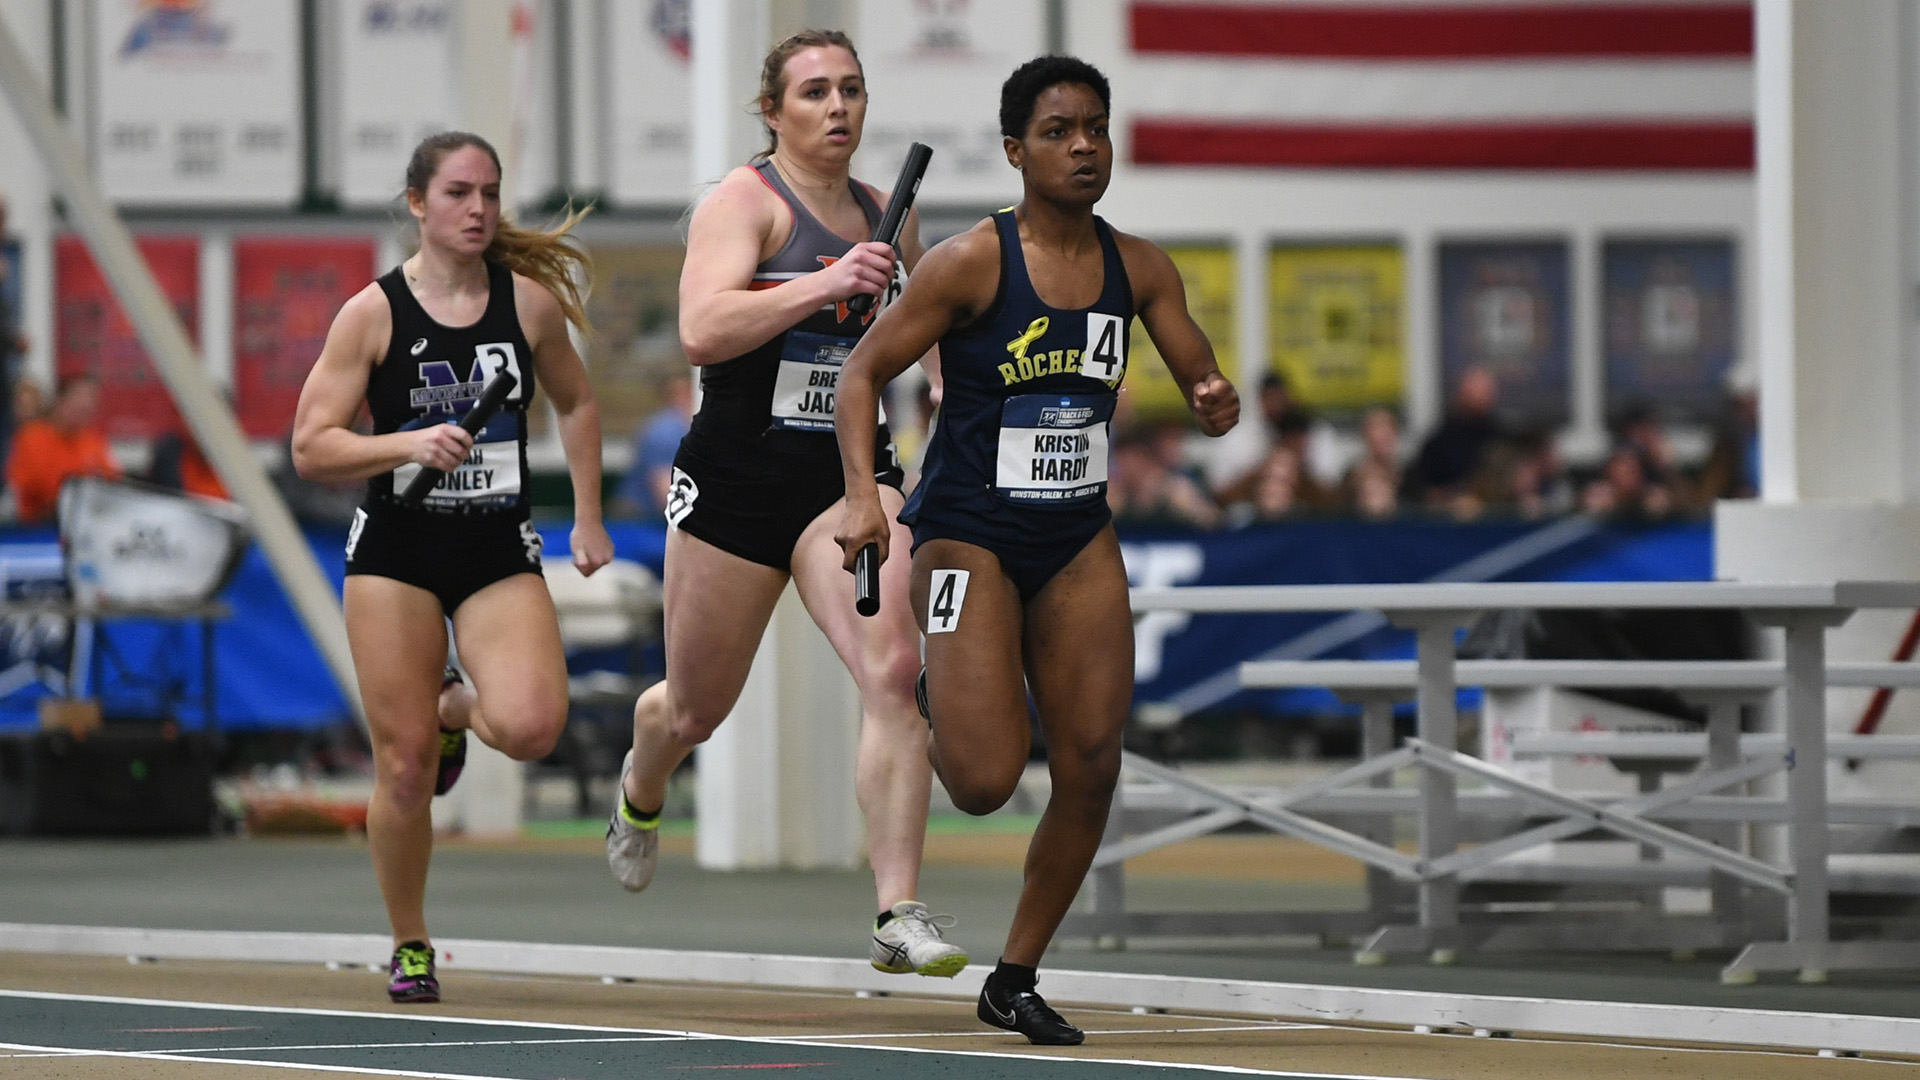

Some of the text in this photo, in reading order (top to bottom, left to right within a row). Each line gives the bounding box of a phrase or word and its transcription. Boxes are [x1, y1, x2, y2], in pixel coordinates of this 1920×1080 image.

[1093, 320, 1118, 376] 4
[808, 370, 839, 387] BRE
[798, 391, 835, 414] JAC
[1034, 433, 1089, 453] KRISTIN
[1031, 456, 1089, 481] HARDY
[932, 574, 957, 628] 4
